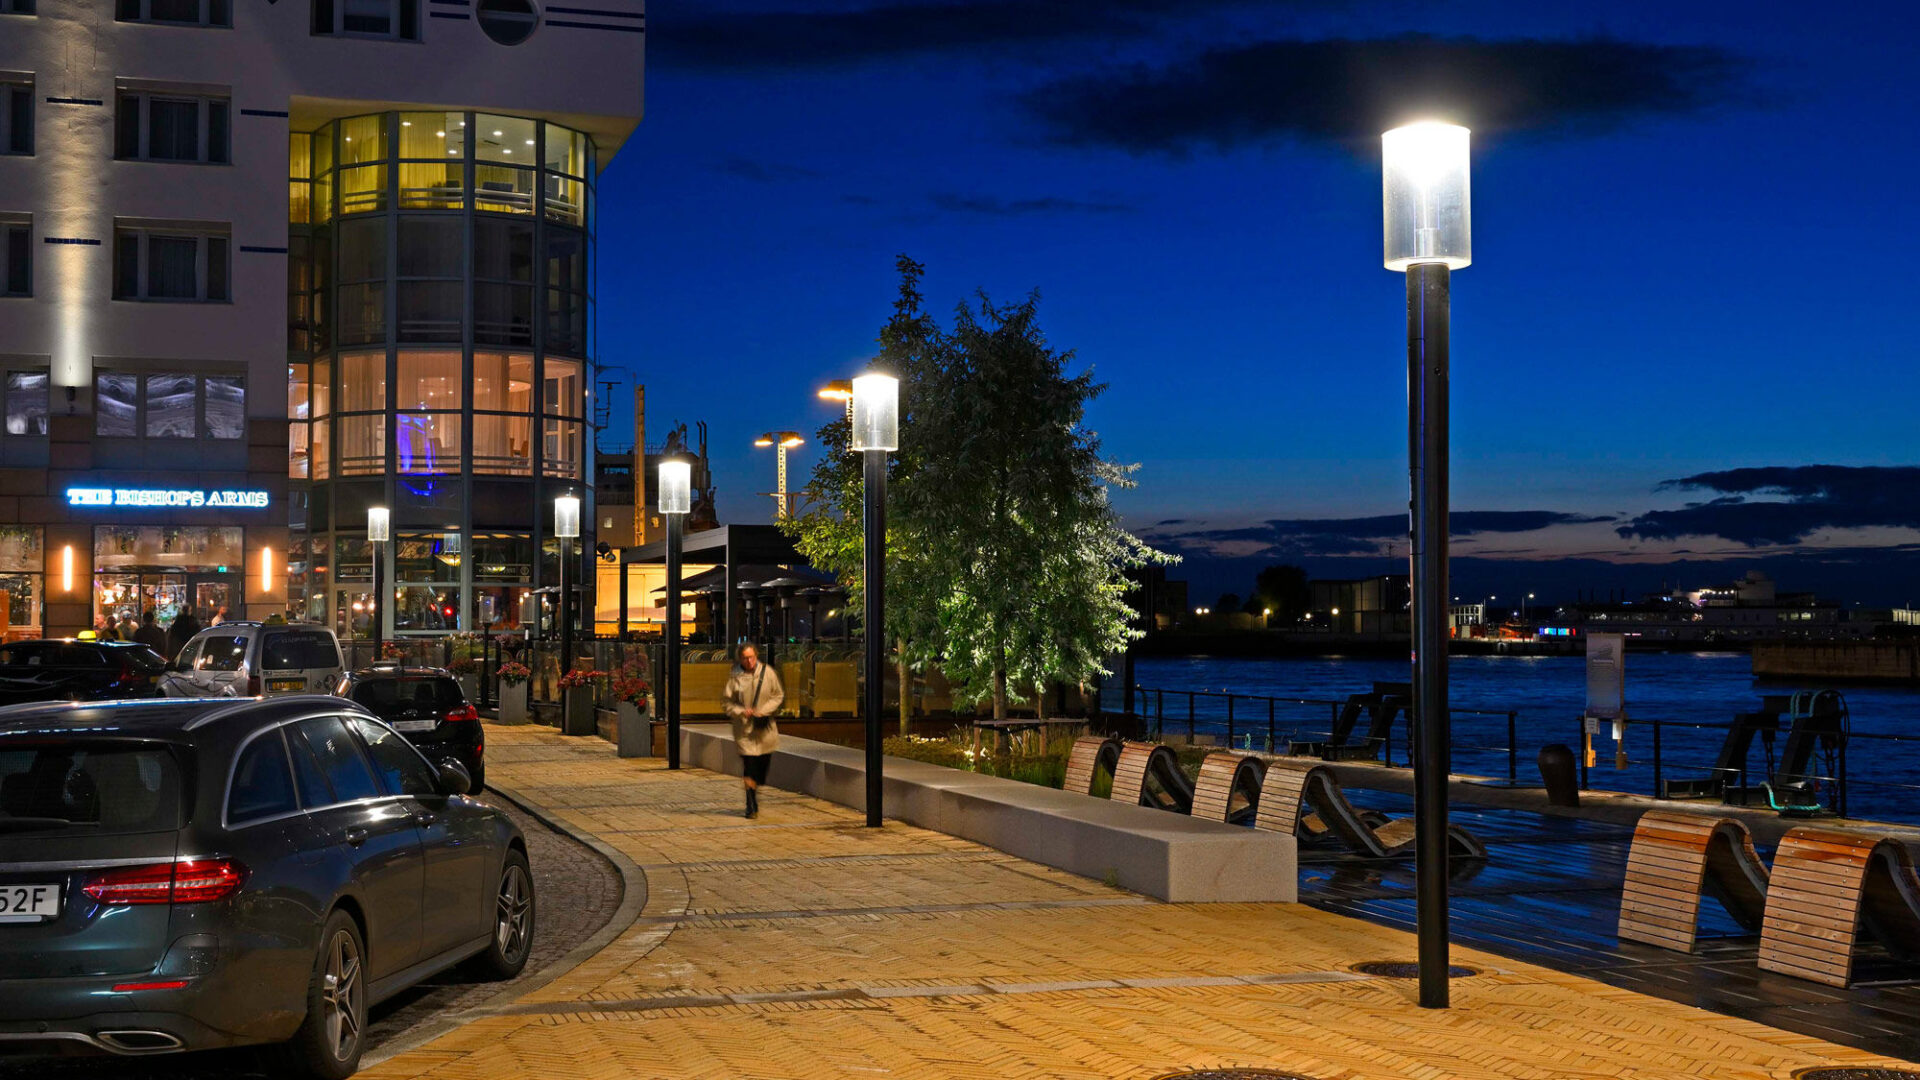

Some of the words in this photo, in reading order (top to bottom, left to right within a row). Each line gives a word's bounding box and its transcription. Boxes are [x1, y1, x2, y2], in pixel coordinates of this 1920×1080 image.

[67, 488, 112, 505] THE
[115, 489, 205, 507] BISHOPS
[206, 491, 269, 507] ARMS
